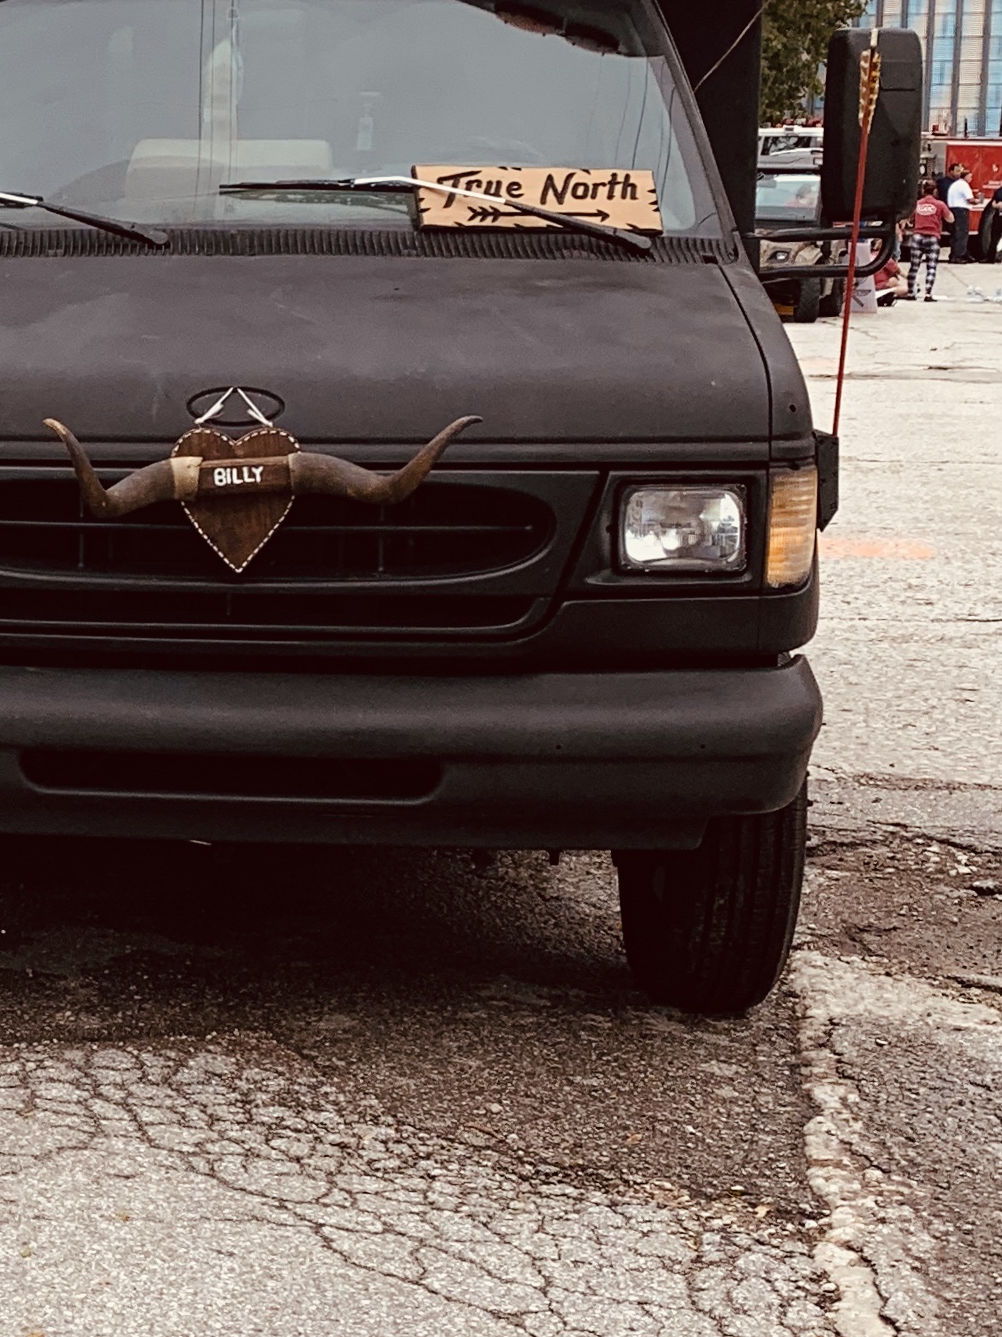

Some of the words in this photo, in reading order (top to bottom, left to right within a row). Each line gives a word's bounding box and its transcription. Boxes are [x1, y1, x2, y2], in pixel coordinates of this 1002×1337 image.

[436, 170, 525, 209] True
[539, 171, 639, 205] North
[213, 465, 264, 487] BILLY
